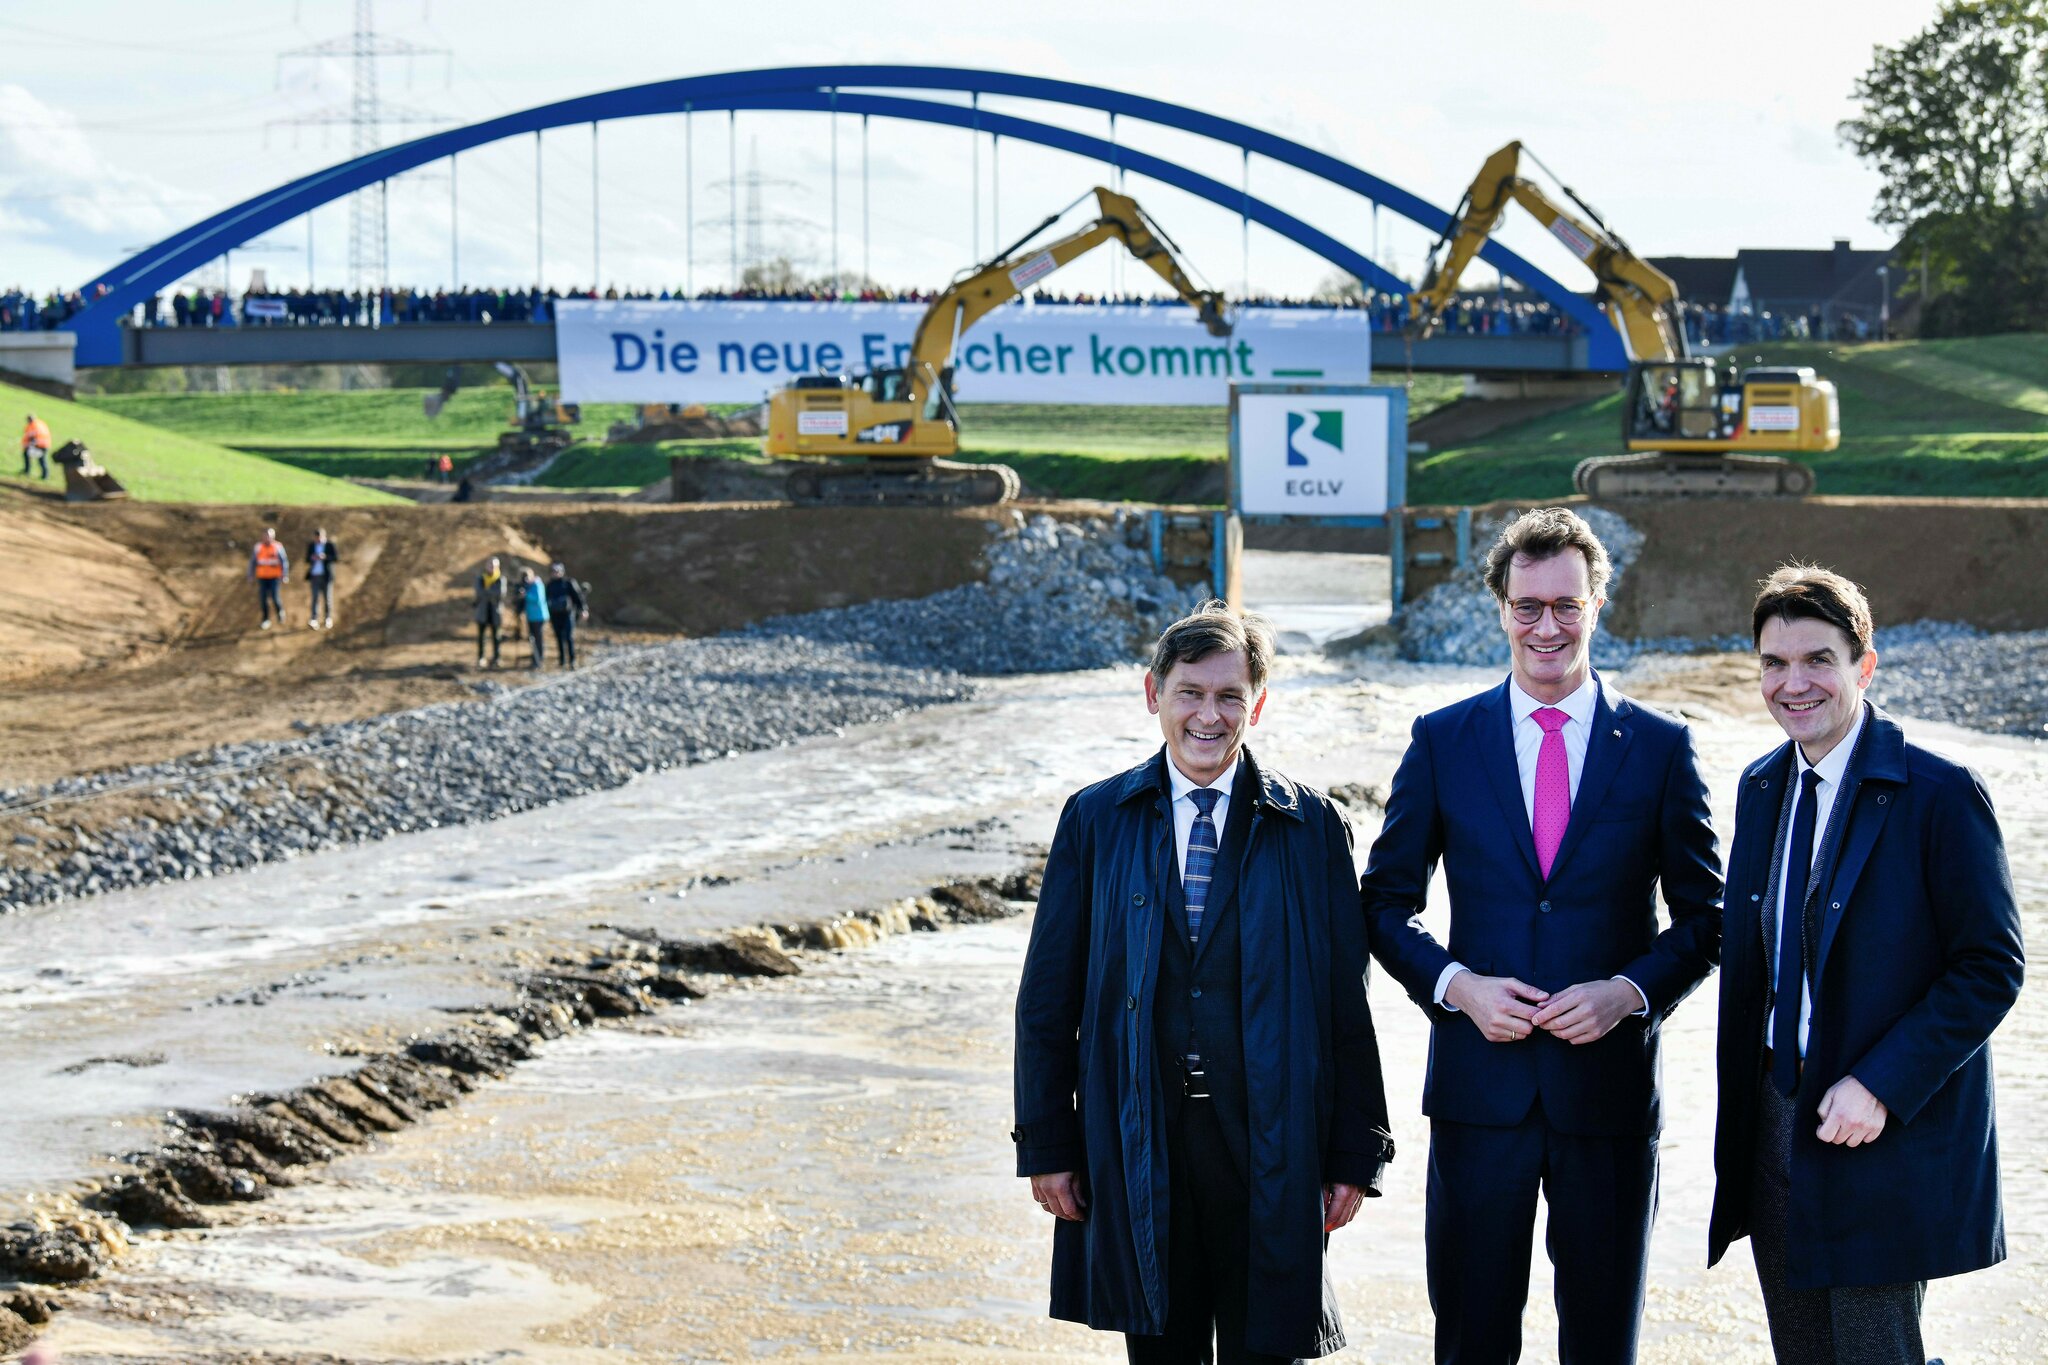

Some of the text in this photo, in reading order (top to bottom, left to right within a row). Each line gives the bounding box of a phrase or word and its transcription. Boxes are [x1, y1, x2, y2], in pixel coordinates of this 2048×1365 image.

[611, 330, 1254, 378] Die neue Echer kommt
[1285, 479, 1344, 497] EGLV
